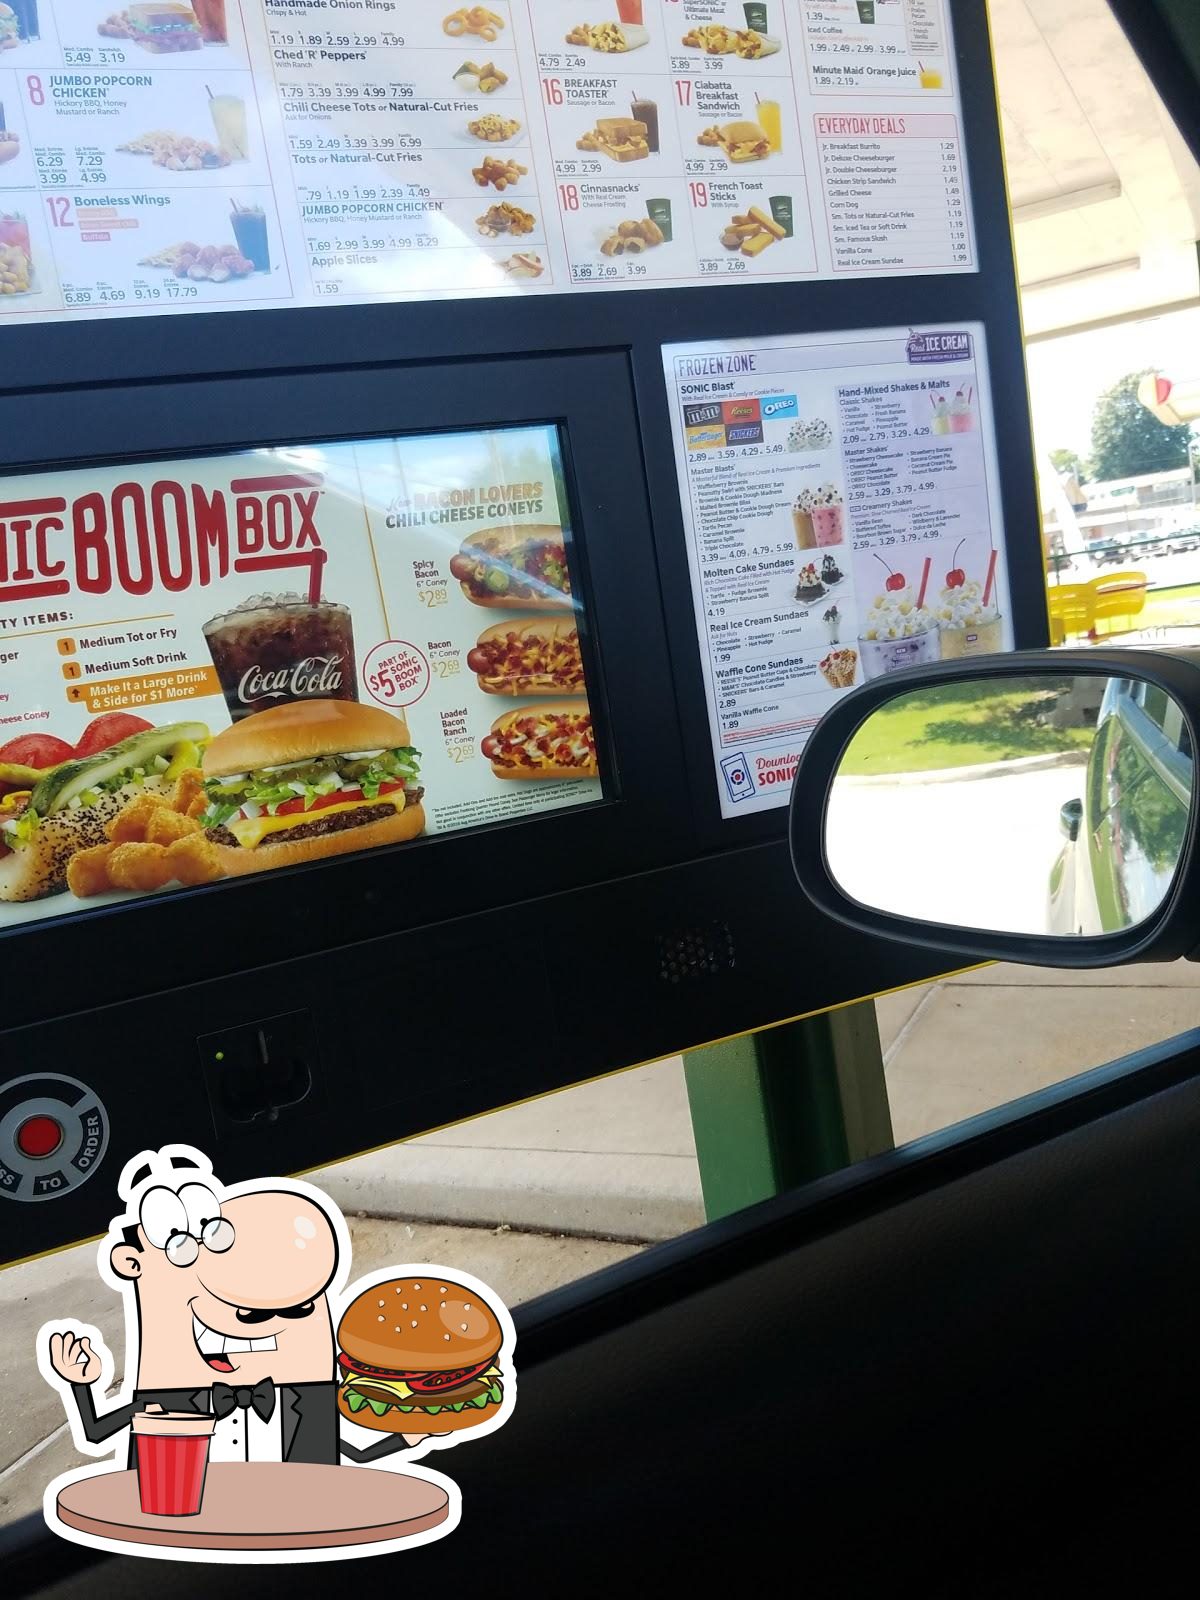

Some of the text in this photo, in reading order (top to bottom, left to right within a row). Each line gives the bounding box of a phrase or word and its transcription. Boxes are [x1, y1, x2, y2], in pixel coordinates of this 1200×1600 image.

[265, 0, 396, 11] Handmade Onion Rings
[266, 9, 287, 17] Crispy
[271, 35, 405, 46] 1.19 1.89 2.59 2.99 4.99
[65, 52, 125, 63] 5.49 3.19
[274, 50, 303, 60] Ched
[539, 58, 586, 67] 4.79 2.49
[813, 66, 841, 75] Minute
[867, 67, 896, 77] Orange
[898, 68, 916, 77] Juice
[49, 76, 152, 87] JUMBO POPCORN
[564, 79, 617, 88] BREAKFAST
[695, 81, 732, 90] Ciabatta
[27, 75, 45, 106] 8
[280, 87, 413, 97] 1.79 3.39 3.99 4.99 7.99
[542, 79, 563, 105] 16
[566, 90, 608, 98] TOASTER
[676, 80, 691, 106] 17
[696, 91, 738, 101] Breakfast
[283, 102, 309, 112] Chili
[311, 102, 351, 112] Cheese
[354, 102, 376, 112] Tots
[389, 102, 452, 111] Natural-Cut
[454, 102, 478, 111] Fries
[697, 101, 740, 110] Sandwich
[819, 118, 905, 134] EVERYDAY DEALS
[36, 156, 103, 166] 6.29 7.29
[292, 154, 316, 164] Tots
[330, 153, 395, 163] Natural-Cut
[397, 152, 422, 162] Fries
[580, 184, 639, 193] Cinnasnacks
[709, 182, 763, 190] French Toast
[74, 194, 171, 206] Boneless Wings
[559, 184, 579, 210] 18
[689, 182, 708, 208] 19
[710, 192, 736, 201] Sticks
[302, 204, 339, 216] JUMBO
[342, 203, 393, 214] POPCORN
[846, 201, 858, 209] Dog
[46, 197, 74, 227] 12
[311, 254, 377, 267] Apple Slices
[700, 261, 745, 271] 3.89 2.69
[65, 287, 197, 302] 6.89 4.69 9.19 17.79
[925, 335, 968, 351] ICE CREAM
[679, 354, 756, 377] FROZEN ZONE
[681, 384, 709, 394] SONIC
[839, 380, 950, 398] Hand-Mixed Shakes & Malts
[764, 400, 794, 416] OREO
[479, 482, 543, 501] LOVERS
[386, 500, 543, 528] CHILI CHEESE CONEYS
[73, 480, 322, 595] BOOM BOX
[413, 560, 434, 570] Spicy
[703, 559, 794, 578] Molten Cake Sundaes
[415, 570, 439, 578] Bacon
[426, 579, 448, 587] Coney
[708, 607, 725, 617] 4.19
[24, 612, 73, 626] ITEMS:
[710, 610, 809, 632] Real Ice Cream Sundaes
[80, 634, 125, 649] Medium
[127, 633, 144, 643] Tot
[146, 631, 158, 640] or
[160, 628, 177, 640] Fry
[428, 640, 451, 650] Bacon
[85, 659, 130, 674] Medium
[132, 657, 155, 668] Soft
[157, 652, 187, 663] Drink
[378, 651, 408, 669] PART OF
[714, 654, 731, 663] 1.99
[715, 657, 803, 678] Waffle Cone Sundaes
[370, 656, 418, 697] $5 SONIC
[395, 665, 422, 682] BOOM
[90, 685, 120, 697] Make
[122, 683, 132, 692] It
[143, 677, 173, 690] Large
[177, 672, 207, 684] Drink
[238, 656, 344, 703] Coca-Cola
[93, 699, 101, 709] &
[104, 695, 129, 707] Side
[131, 693, 146, 703] for
[150, 690, 162, 700] $1
[719, 699, 736, 708] 2.89
[24, 711, 50, 721] Coney
[440, 708, 468, 719] Loaded
[721, 705, 779, 720] Vanilla Waffle Cone
[442, 718, 465, 728] Bacon
[723, 720, 739, 729] 1.89
[444, 726, 467, 736] Ranch
[78, 1115, 99, 1167] ORDER
[40, 1177, 61, 1190] TO
